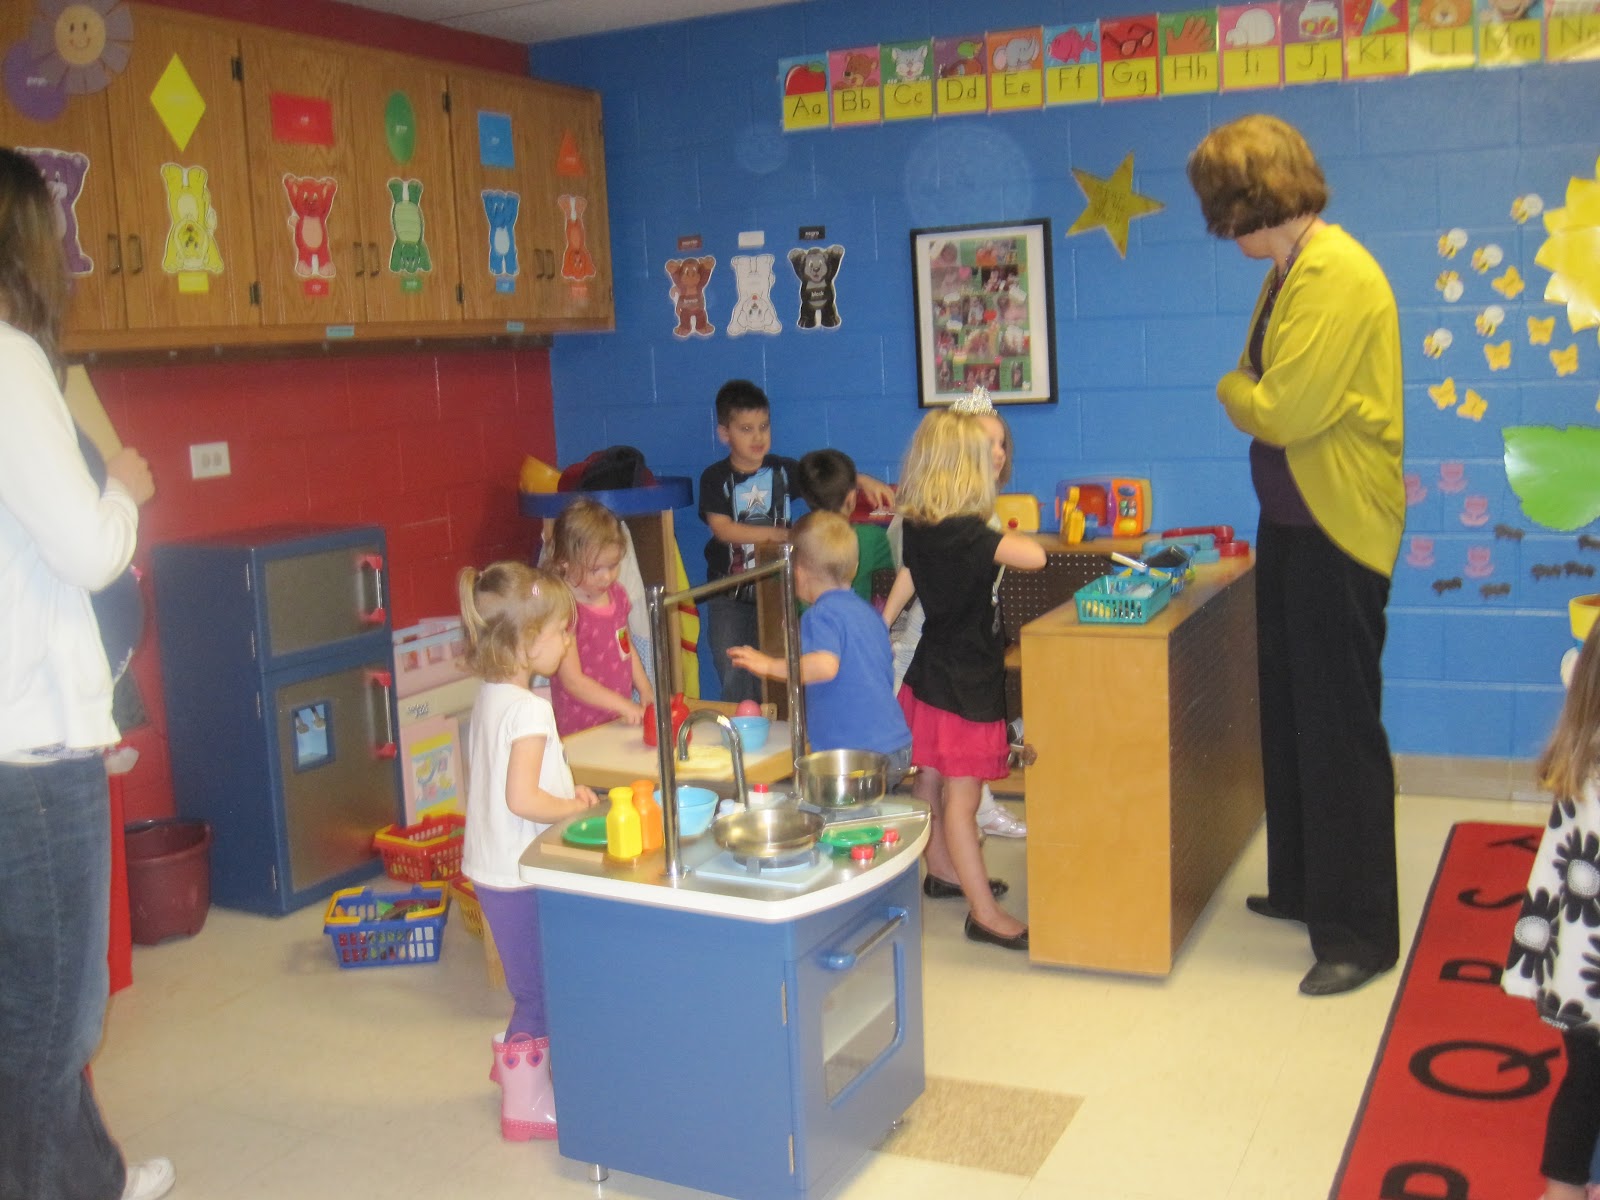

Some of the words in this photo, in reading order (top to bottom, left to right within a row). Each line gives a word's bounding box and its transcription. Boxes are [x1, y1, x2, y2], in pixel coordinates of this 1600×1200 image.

[792, 95, 822, 117] Aa
[841, 90, 871, 112] Bb
[893, 84, 923, 107] Cc
[945, 77, 977, 101] Dd
[1003, 73, 1031, 97] Ee
[1058, 66, 1085, 90] Ff
[1112, 62, 1148, 97] Gg
[1173, 55, 1207, 82] Hh
[1297, 43, 1328, 81] Jj
[1360, 36, 1395, 63] Kk
[1485, 22, 1535, 53] Mm
[1409, 1041, 1561, 1101] Q
